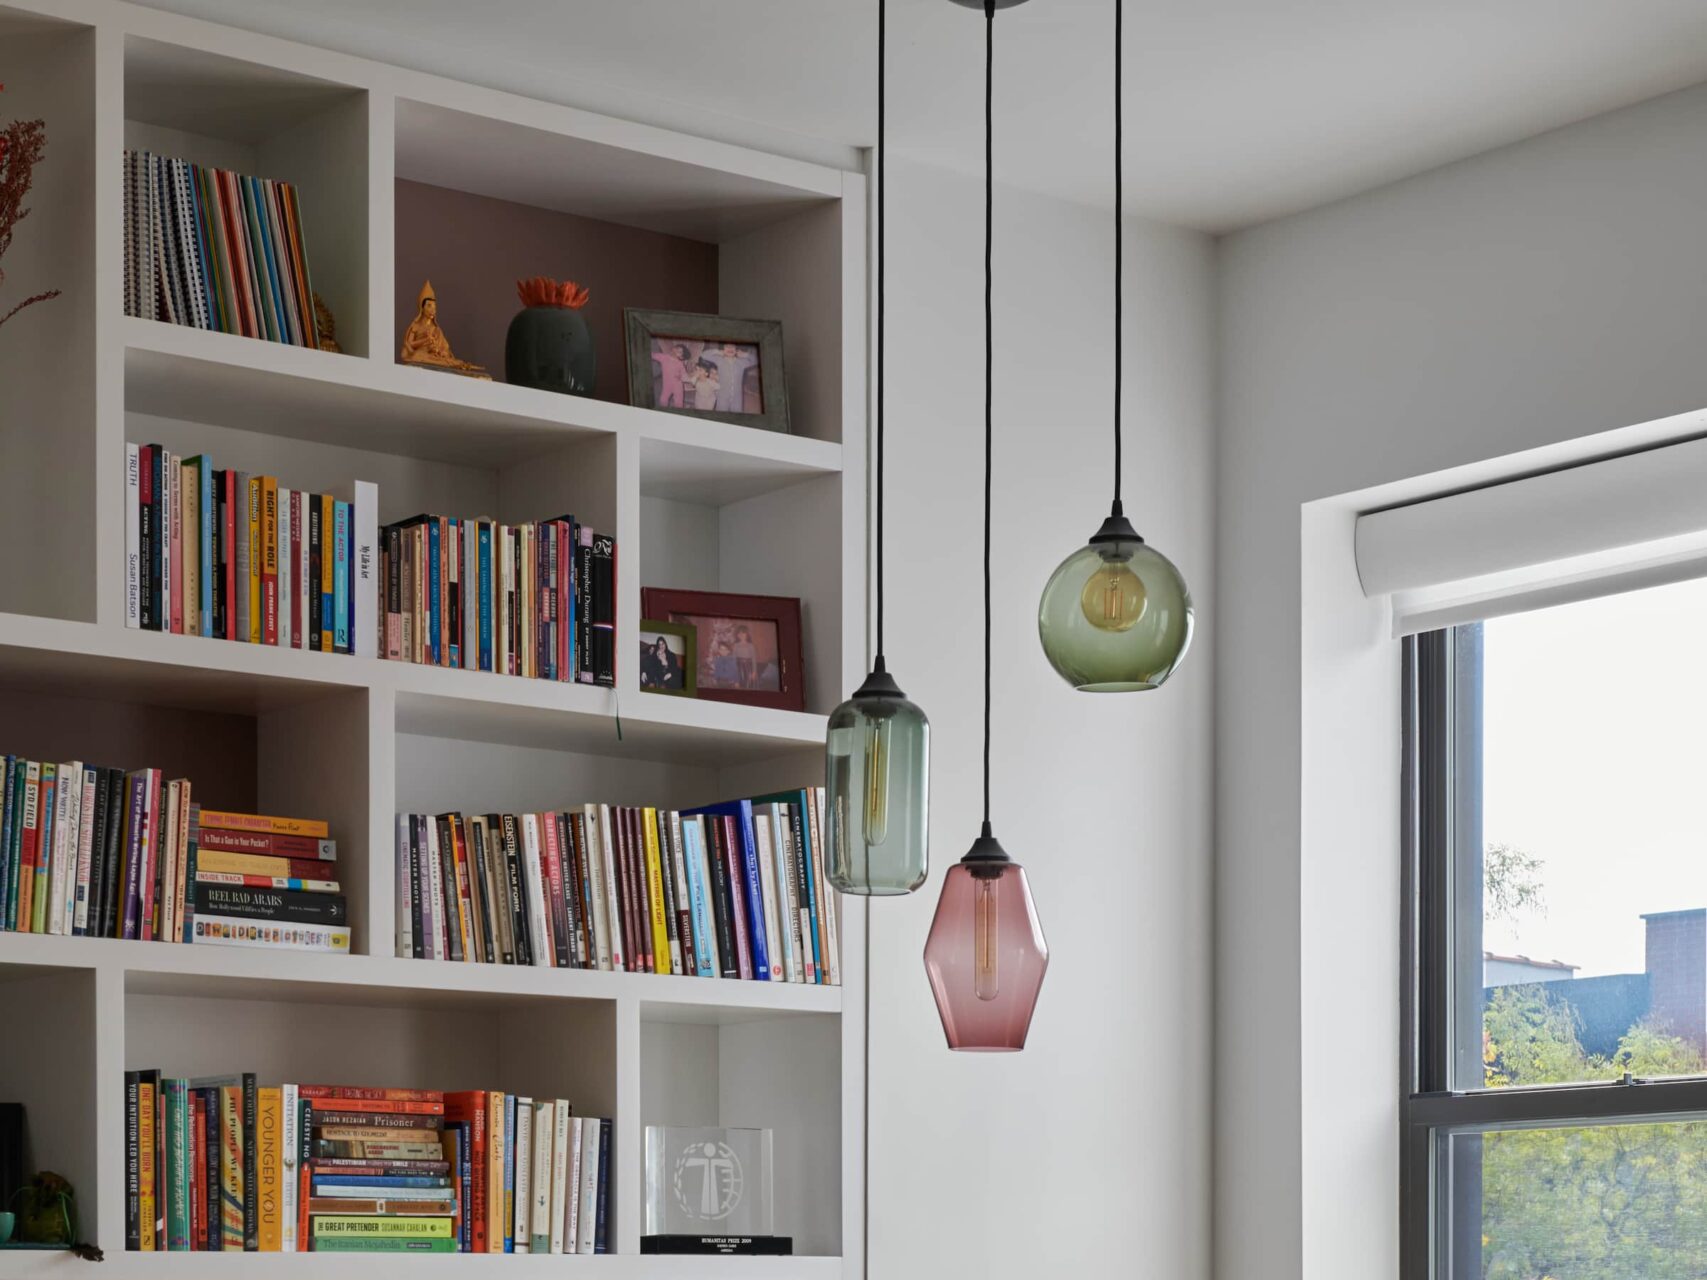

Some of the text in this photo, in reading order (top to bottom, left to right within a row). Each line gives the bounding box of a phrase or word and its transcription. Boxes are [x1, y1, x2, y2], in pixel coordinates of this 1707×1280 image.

[130, 454, 138, 486] TRUTH
[129, 553, 138, 618] Susan Batson
[361, 570, 370, 578] Art
[582, 548, 591, 623] Christopher Durang
[26, 786, 36, 827] SYD FIELD
[504, 816, 516, 856] EISENSTEIN
[512, 886, 520, 912] FORM
[794, 816, 805, 889] CINEMATOGRAPHY
[198, 873, 220, 881] INSIDE
[784, 840, 800, 943] CINEMATOGRAPHY DIRECTORS
[208, 890, 282, 906] REEL BAD ARABS
[655, 899, 661, 907] OF
[683, 914, 692, 947] SILVERSTEIN
[129, 1084, 137, 1102] YOUR
[129, 1104, 137, 1141] INTUITION
[142, 1088, 151, 1172] ONE DAY YOU'LL BURN
[286, 1093, 294, 1146] INITIATION
[374, 1116, 413, 1127] Prisoner
[262, 1107, 275, 1223] YOUNGER YOU
[303, 1145, 310, 1158] NG
[326, 1222, 344, 1231] GREAT
[346, 1222, 379, 1232] PRETENDER
[323, 1240, 336, 1248] The
